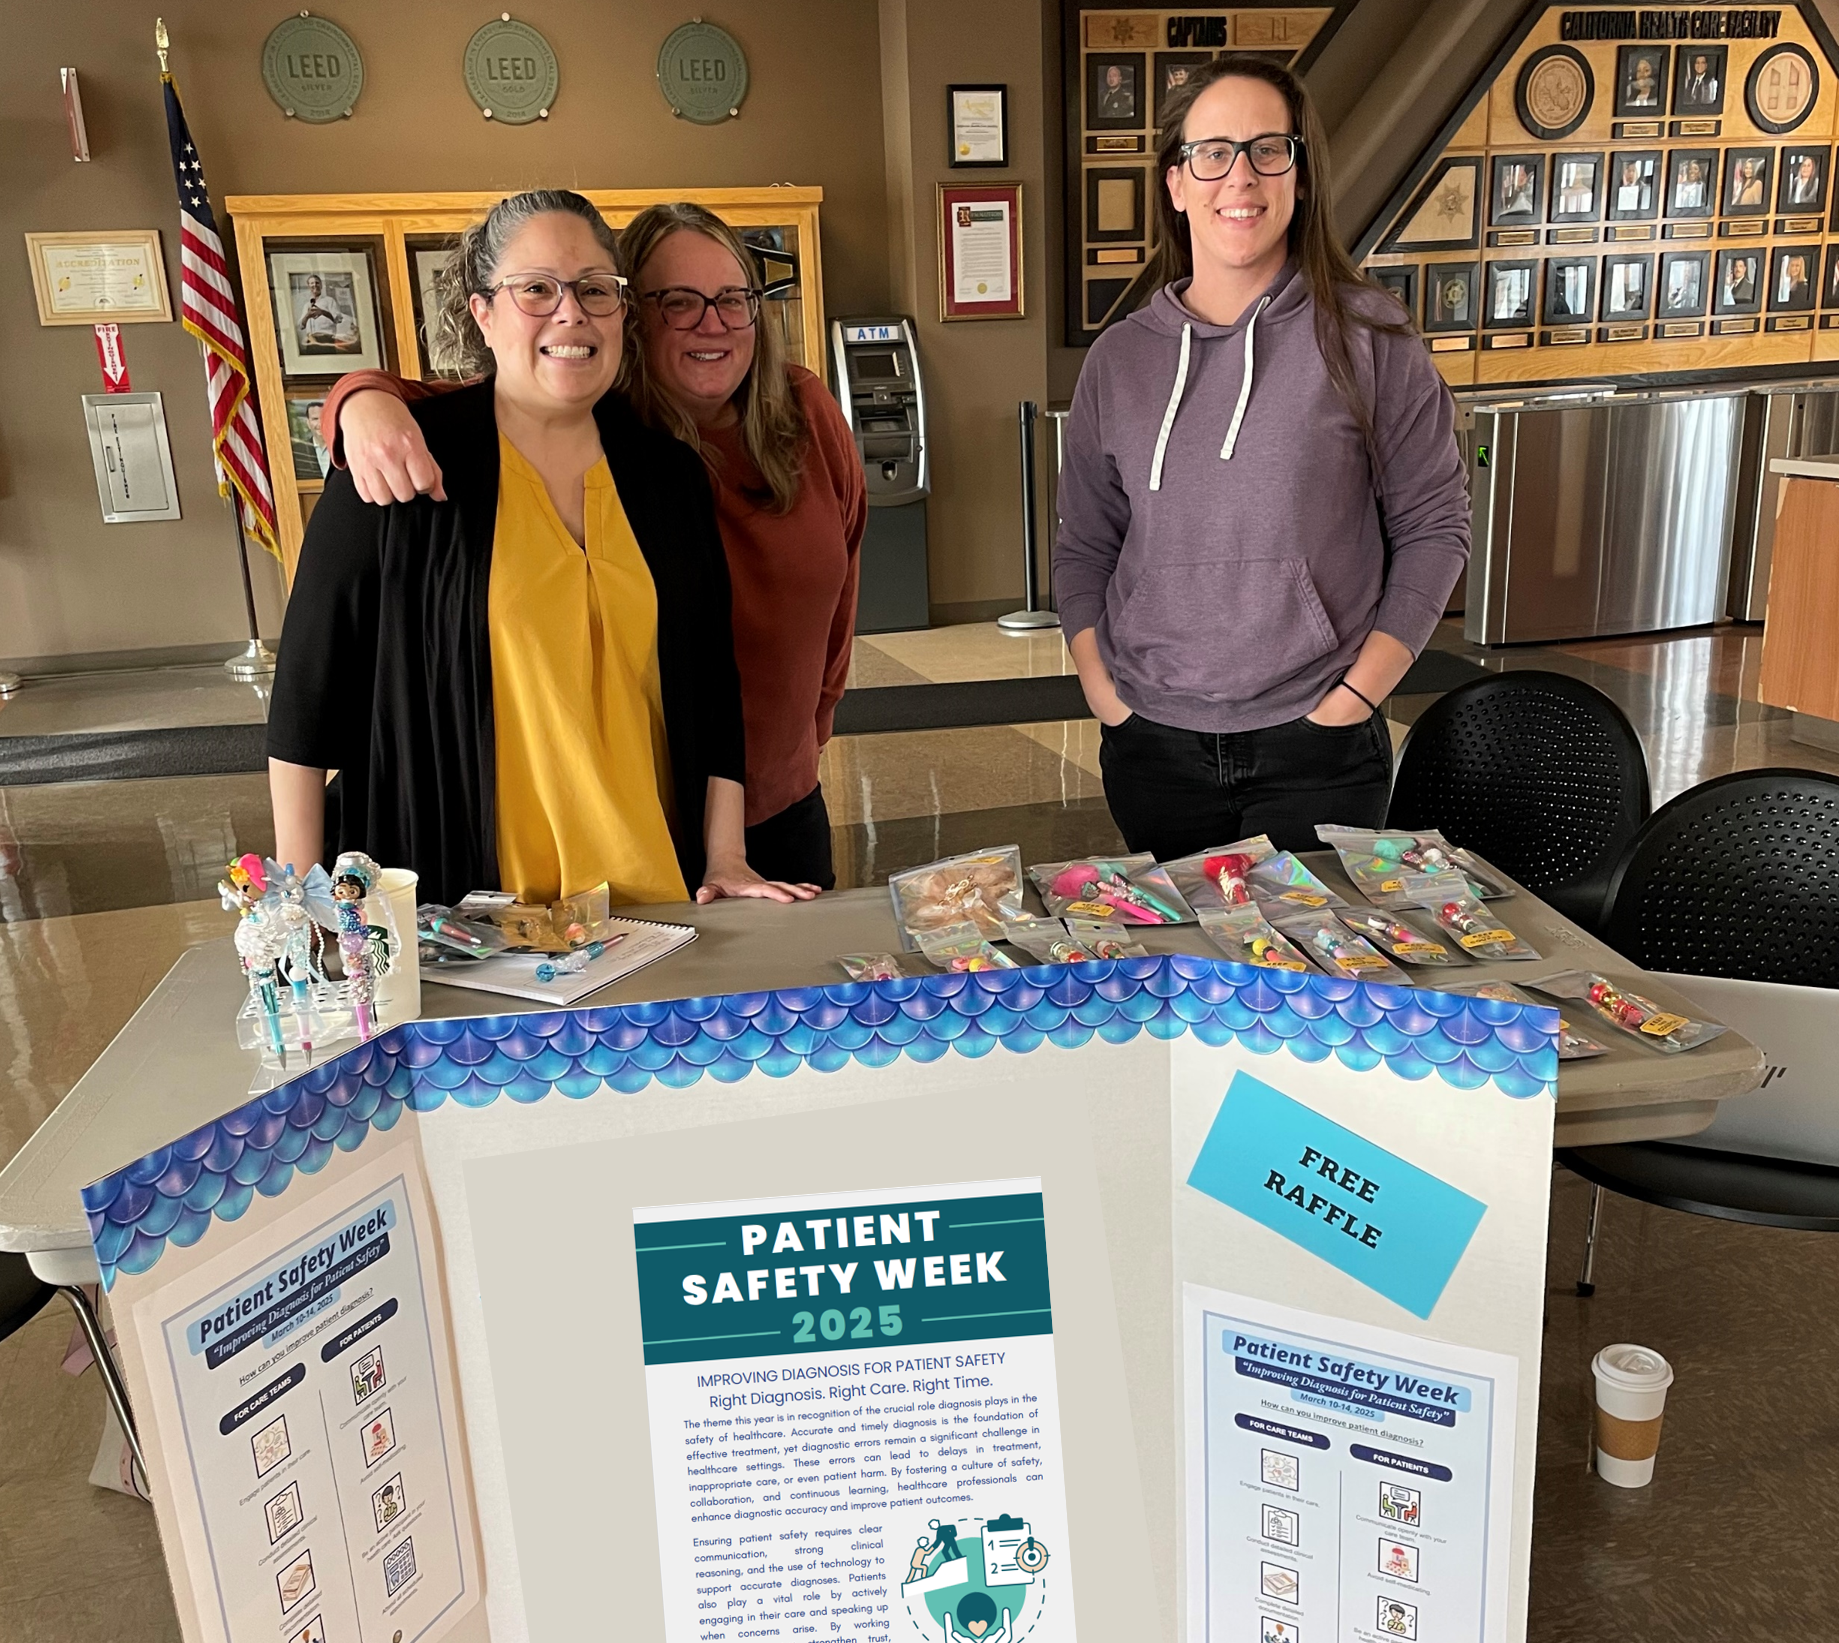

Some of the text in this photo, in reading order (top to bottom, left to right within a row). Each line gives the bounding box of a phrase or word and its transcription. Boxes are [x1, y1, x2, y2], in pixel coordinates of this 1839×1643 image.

[1561, 11, 1782, 40] CALIFORNIA HEALTH CARE FACILITY
[287, 54, 341, 78] LEED
[486, 57, 536, 80] LEED
[679, 59, 725, 81] LEED
[301, 84, 332, 92] SILVER
[56, 258, 140, 268] ACCREDITATION
[857, 327, 889, 340] ATM
[1298, 1145, 1380, 1204] FREE
[1263, 1168, 1383, 1249] RAFFLE
[742, 1211, 940, 1255] PATIENT
[201, 1209, 387, 1343] Patient Safety Week
[683, 1251, 1006, 1305] SAFETY WEEK
[214, 1239, 384, 1357] “Improving Diagnosis for Patient Safety”
[272, 1294, 333, 1342] March 10-14, 2025
[340, 1314, 382, 1347] FOR PATIENTS
[792, 1305, 902, 1343] 2025
[239, 1288, 373, 1385] How can you improve patient diagnosis?
[697, 1352, 1005, 1387] IMPROVING DIAGNOSIS FOR PATIENT SAFETY
[1234, 1336, 1459, 1404] Patient Safety Week
[234, 1376, 292, 1421] FOR CARE TEAMS
[710, 1376, 993, 1411] Right Diagnosis. Right Care. Right Time.
[1243, 1362, 1450, 1422] “Improving Diagnosis for Patient Safety”
[1300, 1393, 1374, 1417] March 10-14, 2025
[684, 1420, 700, 1429] The
[703, 1418, 732, 1427] theme
[735, 1416, 751, 1425] this
[754, 1416, 774, 1426] year
[798, 1410, 850, 1421] recognition
[853, 1406, 862, 1416] of
[866, 1406, 881, 1414] the
[884, 1402, 915, 1414] crucial
[918, 1401, 935, 1411] role
[938, 1400, 982, 1411] diagnosis
[985, 1396, 1008, 1408] plays
[1022, 1394, 1037, 1403] the
[685, 1435, 714, 1445] safety
[718, 1432, 728, 1442] of
[733, 1430, 785, 1441] healthcare.
[791, 1427, 833, 1436] Accurate
[838, 1423, 856, 1433] and
[861, 1421, 888, 1432] timely
[893, 1418, 937, 1430] diagnosis
[953, 1415, 969, 1423] the
[973, 1412, 1024, 1422] foundation
[1029, 1408, 1038, 1418] of
[1261, 1399, 1279, 1409] How
[1297, 1410, 1312, 1418] you
[1314, 1413, 1346, 1428] improve
[1348, 1423, 1379, 1438] patient
[1380, 1430, 1424, 1447] diagnosis?
[686, 1450, 728, 1461] effective
[732, 1446, 780, 1457] treatment,
[784, 1445, 798, 1455] yet
[802, 1441, 850, 1453] diagnostic
[854, 1440, 881, 1448] errors
[884, 1437, 916, 1445] remain
[930, 1431, 978, 1444] significant
[982, 1427, 1027, 1438] challenge
[1250, 1420, 1313, 1442] FOR CARE TEAMS
[687, 1465, 738, 1475] healthcare
[746, 1462, 785, 1472] settings.
[793, 1458, 820, 1467] These
[829, 1457, 855, 1465] errors
[890, 1450, 910, 1460] lead
[919, 1450, 929, 1458] to
[938, 1446, 968, 1457] delays
[993, 1441, 1041, 1452] treatment,
[1373, 1454, 1429, 1474] FOR PATIENTS
[988, 1540, 994, 1551] 1
[991, 1563, 998, 1574] 2
